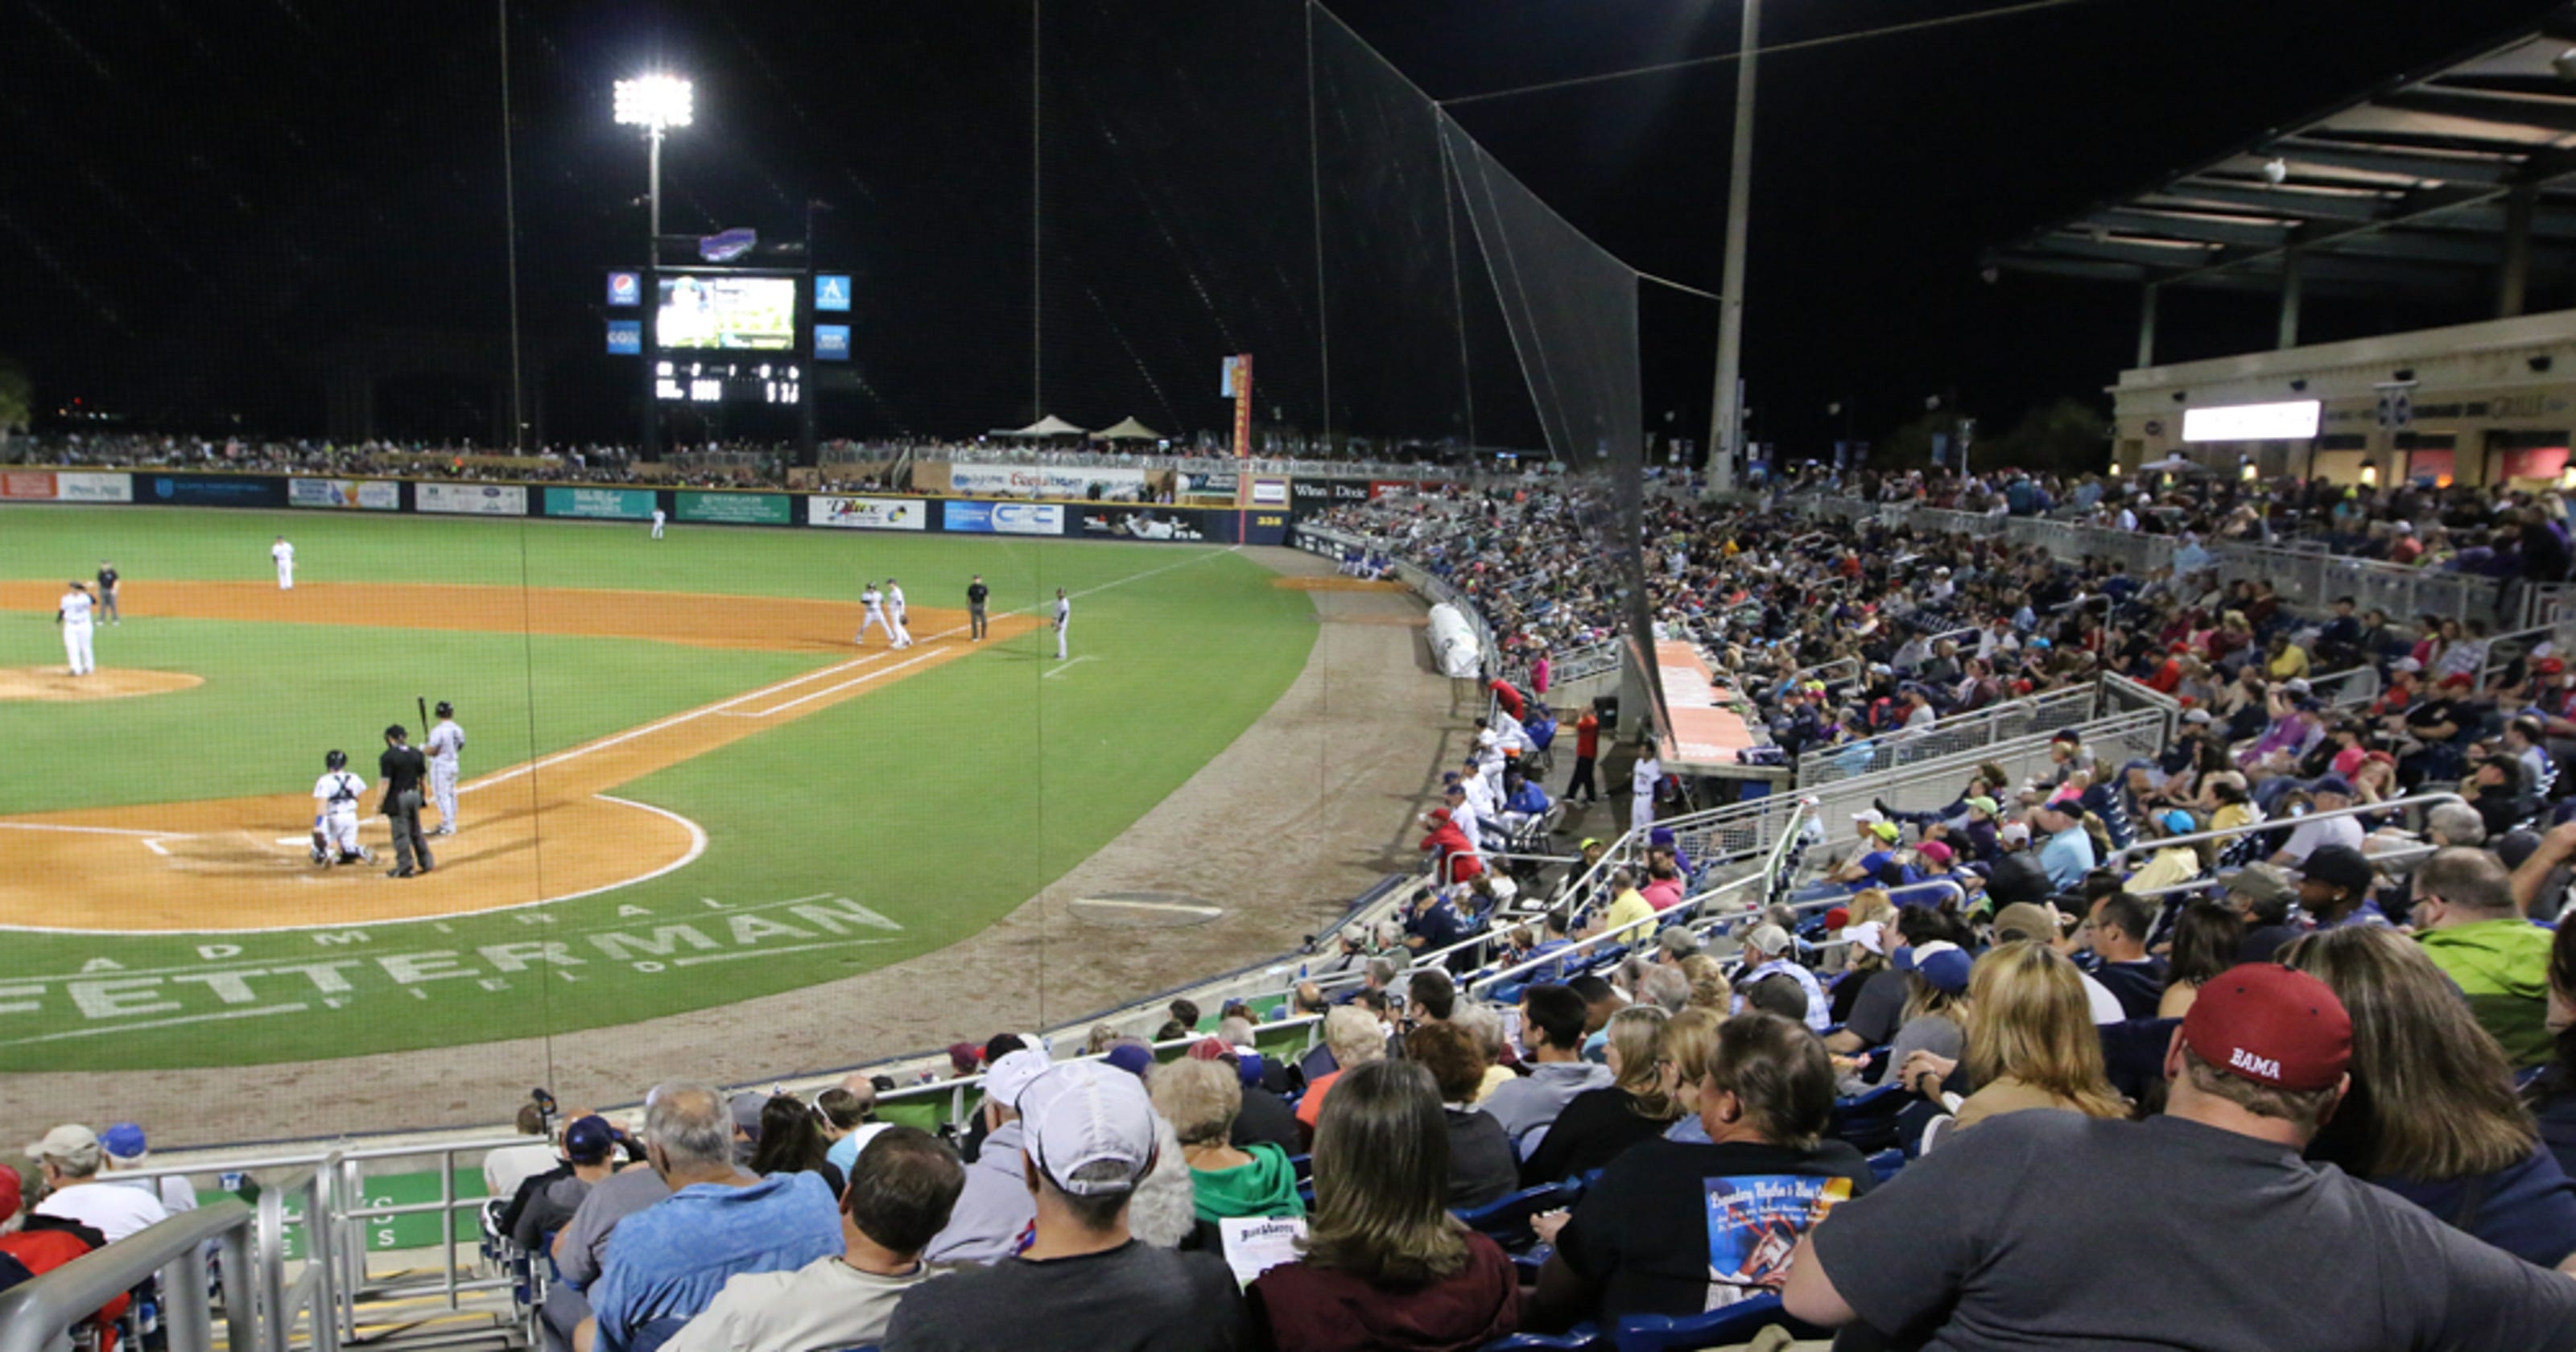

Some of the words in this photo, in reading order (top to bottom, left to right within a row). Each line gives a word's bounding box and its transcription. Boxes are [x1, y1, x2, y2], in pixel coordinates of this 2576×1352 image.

[1294, 484, 1327, 497] Winn
[81, 897, 737, 972] ADMIRAL
[2229, 1047, 2281, 1080] BAMA
